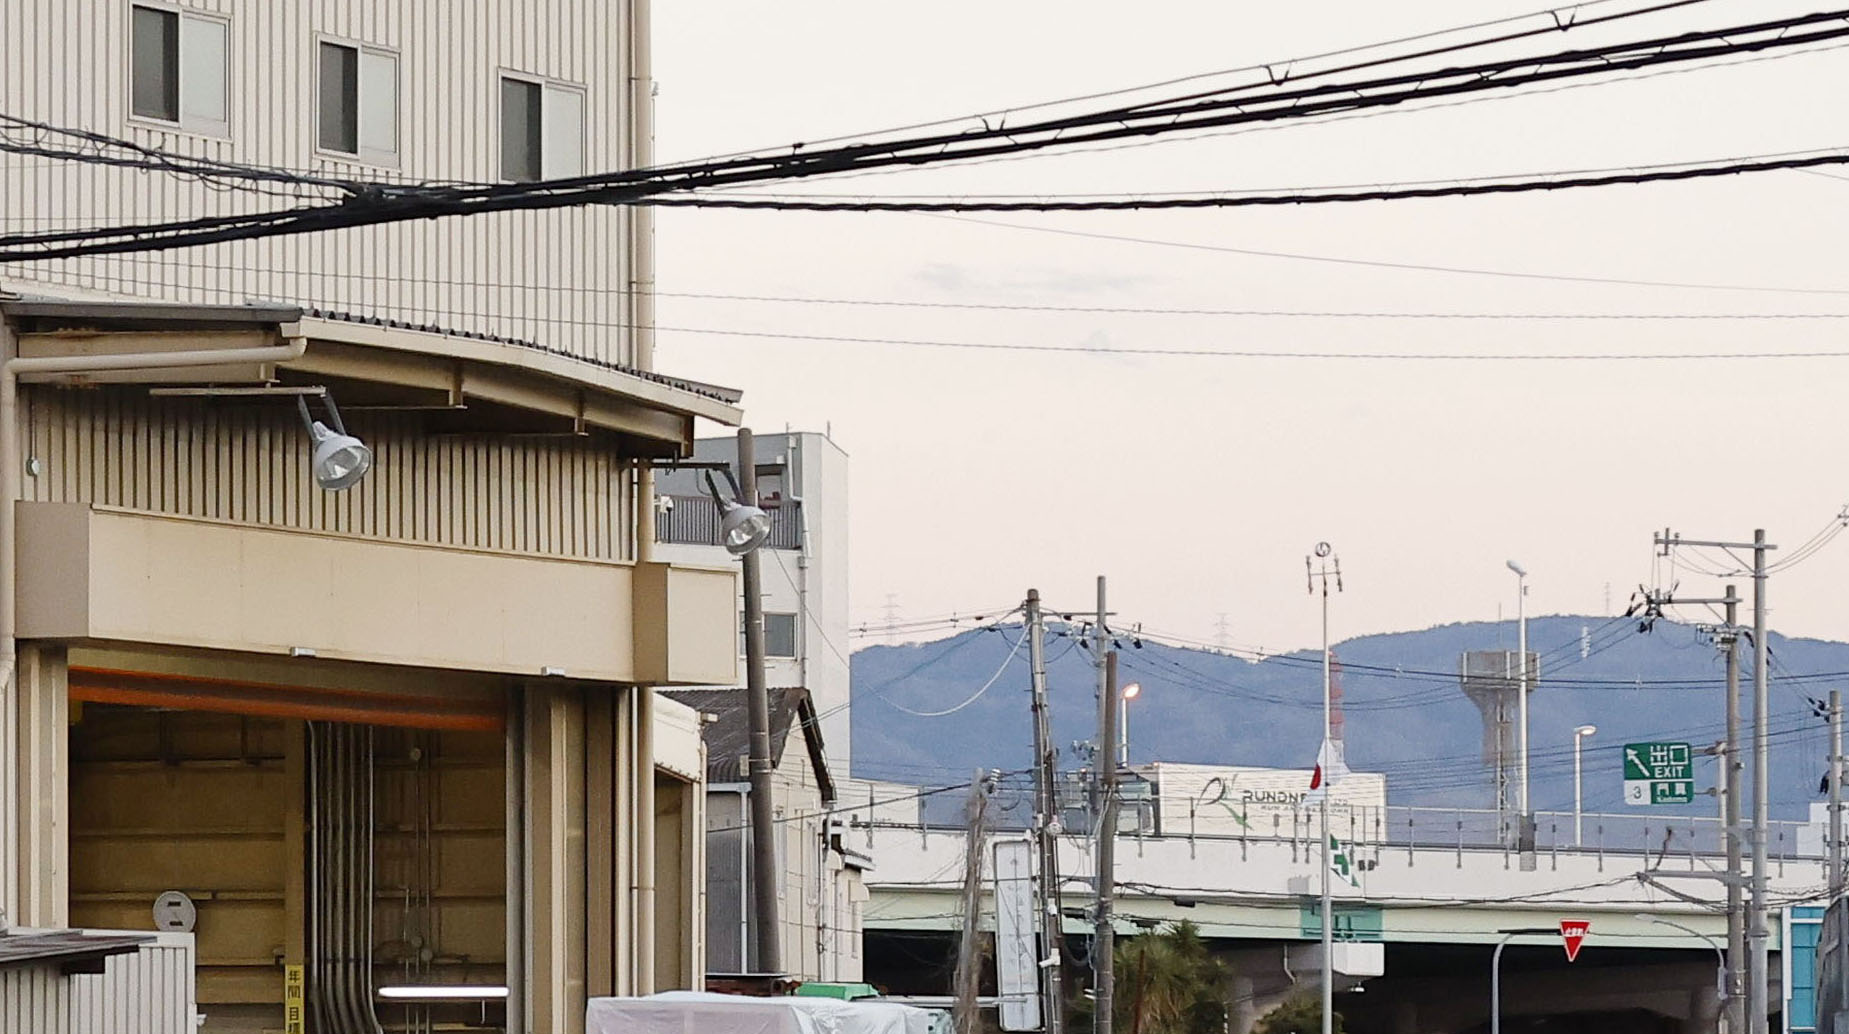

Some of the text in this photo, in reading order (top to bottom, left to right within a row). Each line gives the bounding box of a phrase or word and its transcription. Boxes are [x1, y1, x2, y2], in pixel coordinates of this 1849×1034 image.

[1650, 745, 1688, 766] 出口
[1655, 766, 1684, 778] EXIT
[1633, 786, 1642, 800] 3
[288, 970, 301, 999] 年間
